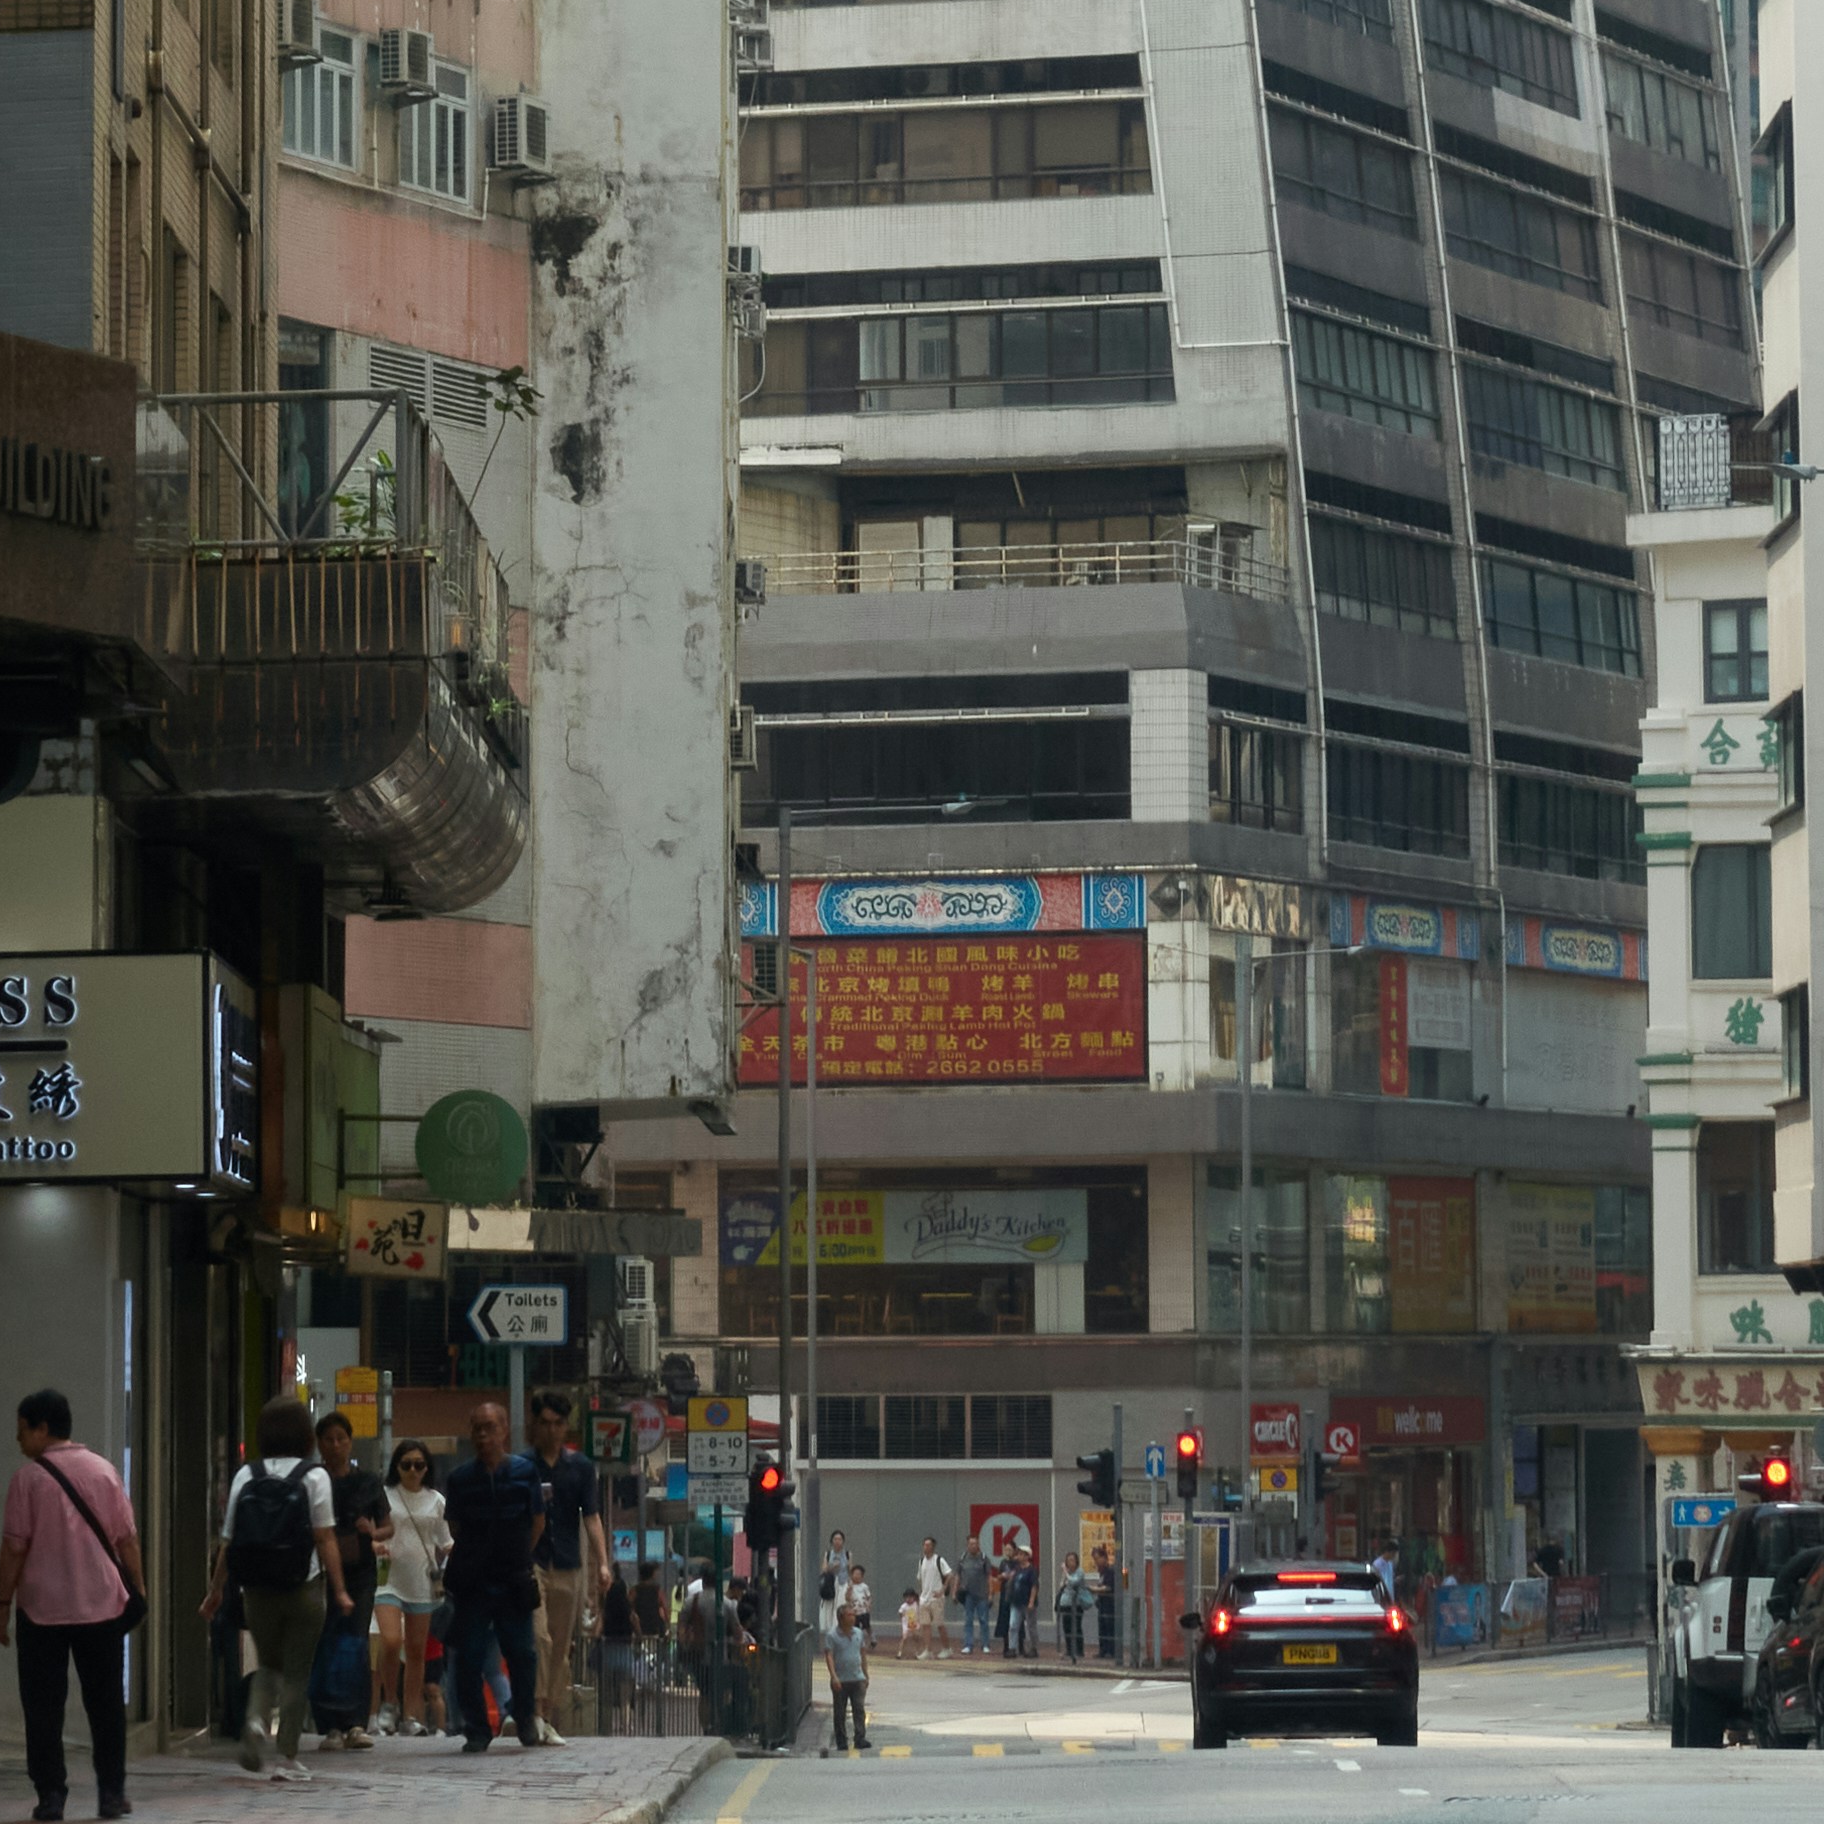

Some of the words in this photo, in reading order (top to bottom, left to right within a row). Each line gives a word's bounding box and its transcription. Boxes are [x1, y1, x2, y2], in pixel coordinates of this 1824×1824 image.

[927, 1060, 982, 1074] 2662
[988, 1059, 1044, 1074] 0555
[505, 1292, 558, 1307] Toilets
